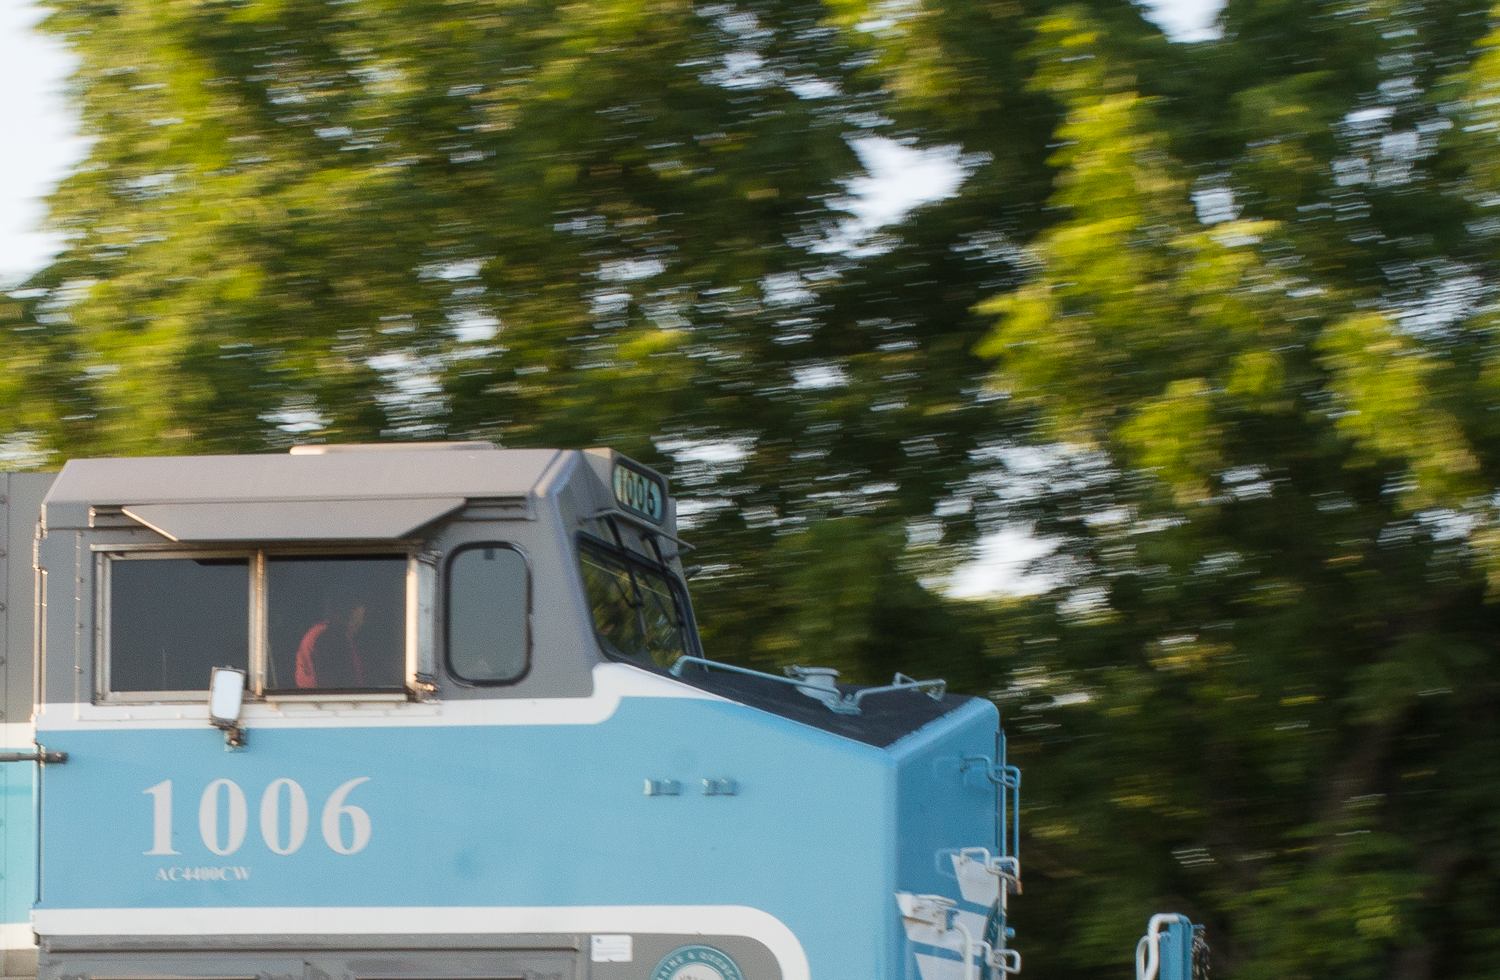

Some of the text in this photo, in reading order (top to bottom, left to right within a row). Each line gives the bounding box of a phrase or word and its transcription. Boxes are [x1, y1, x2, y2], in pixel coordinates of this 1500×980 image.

[619, 466, 656, 517] 1006
[141, 776, 372, 856] 1006
[155, 866, 251, 881] AC4400CW
